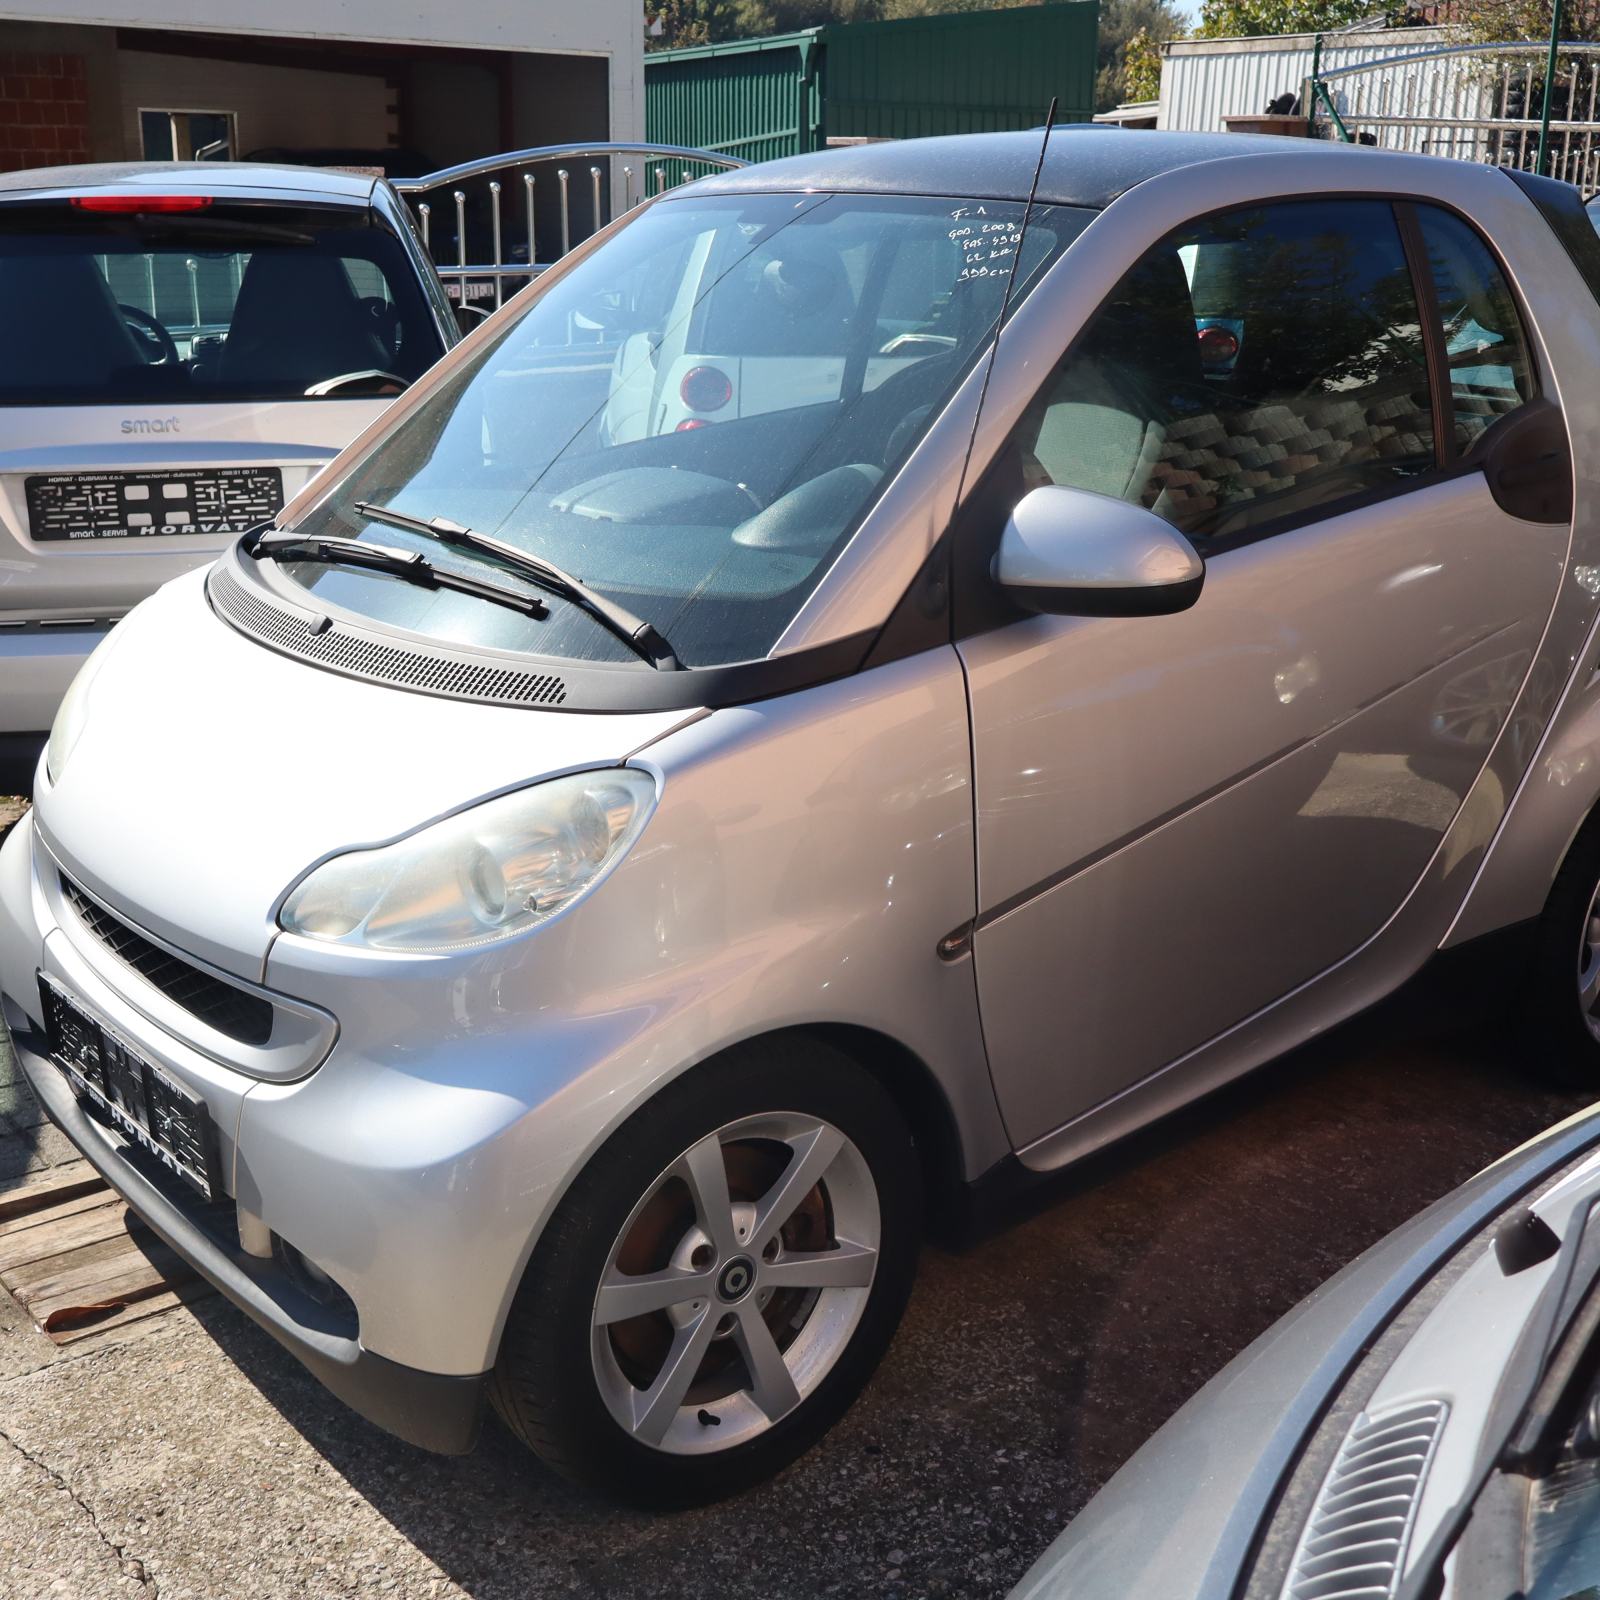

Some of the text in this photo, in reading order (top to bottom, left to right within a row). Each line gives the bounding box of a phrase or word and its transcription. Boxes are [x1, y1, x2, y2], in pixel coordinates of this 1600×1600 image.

[982, 222, 1016, 233] 2008
[121, 416, 180, 433] smart
[69, 530, 95, 539] smart
[102, 529, 128, 537] SERVIS
[140, 522, 248, 535] HORVAT
[111, 1105, 184, 1177] HORVAT
